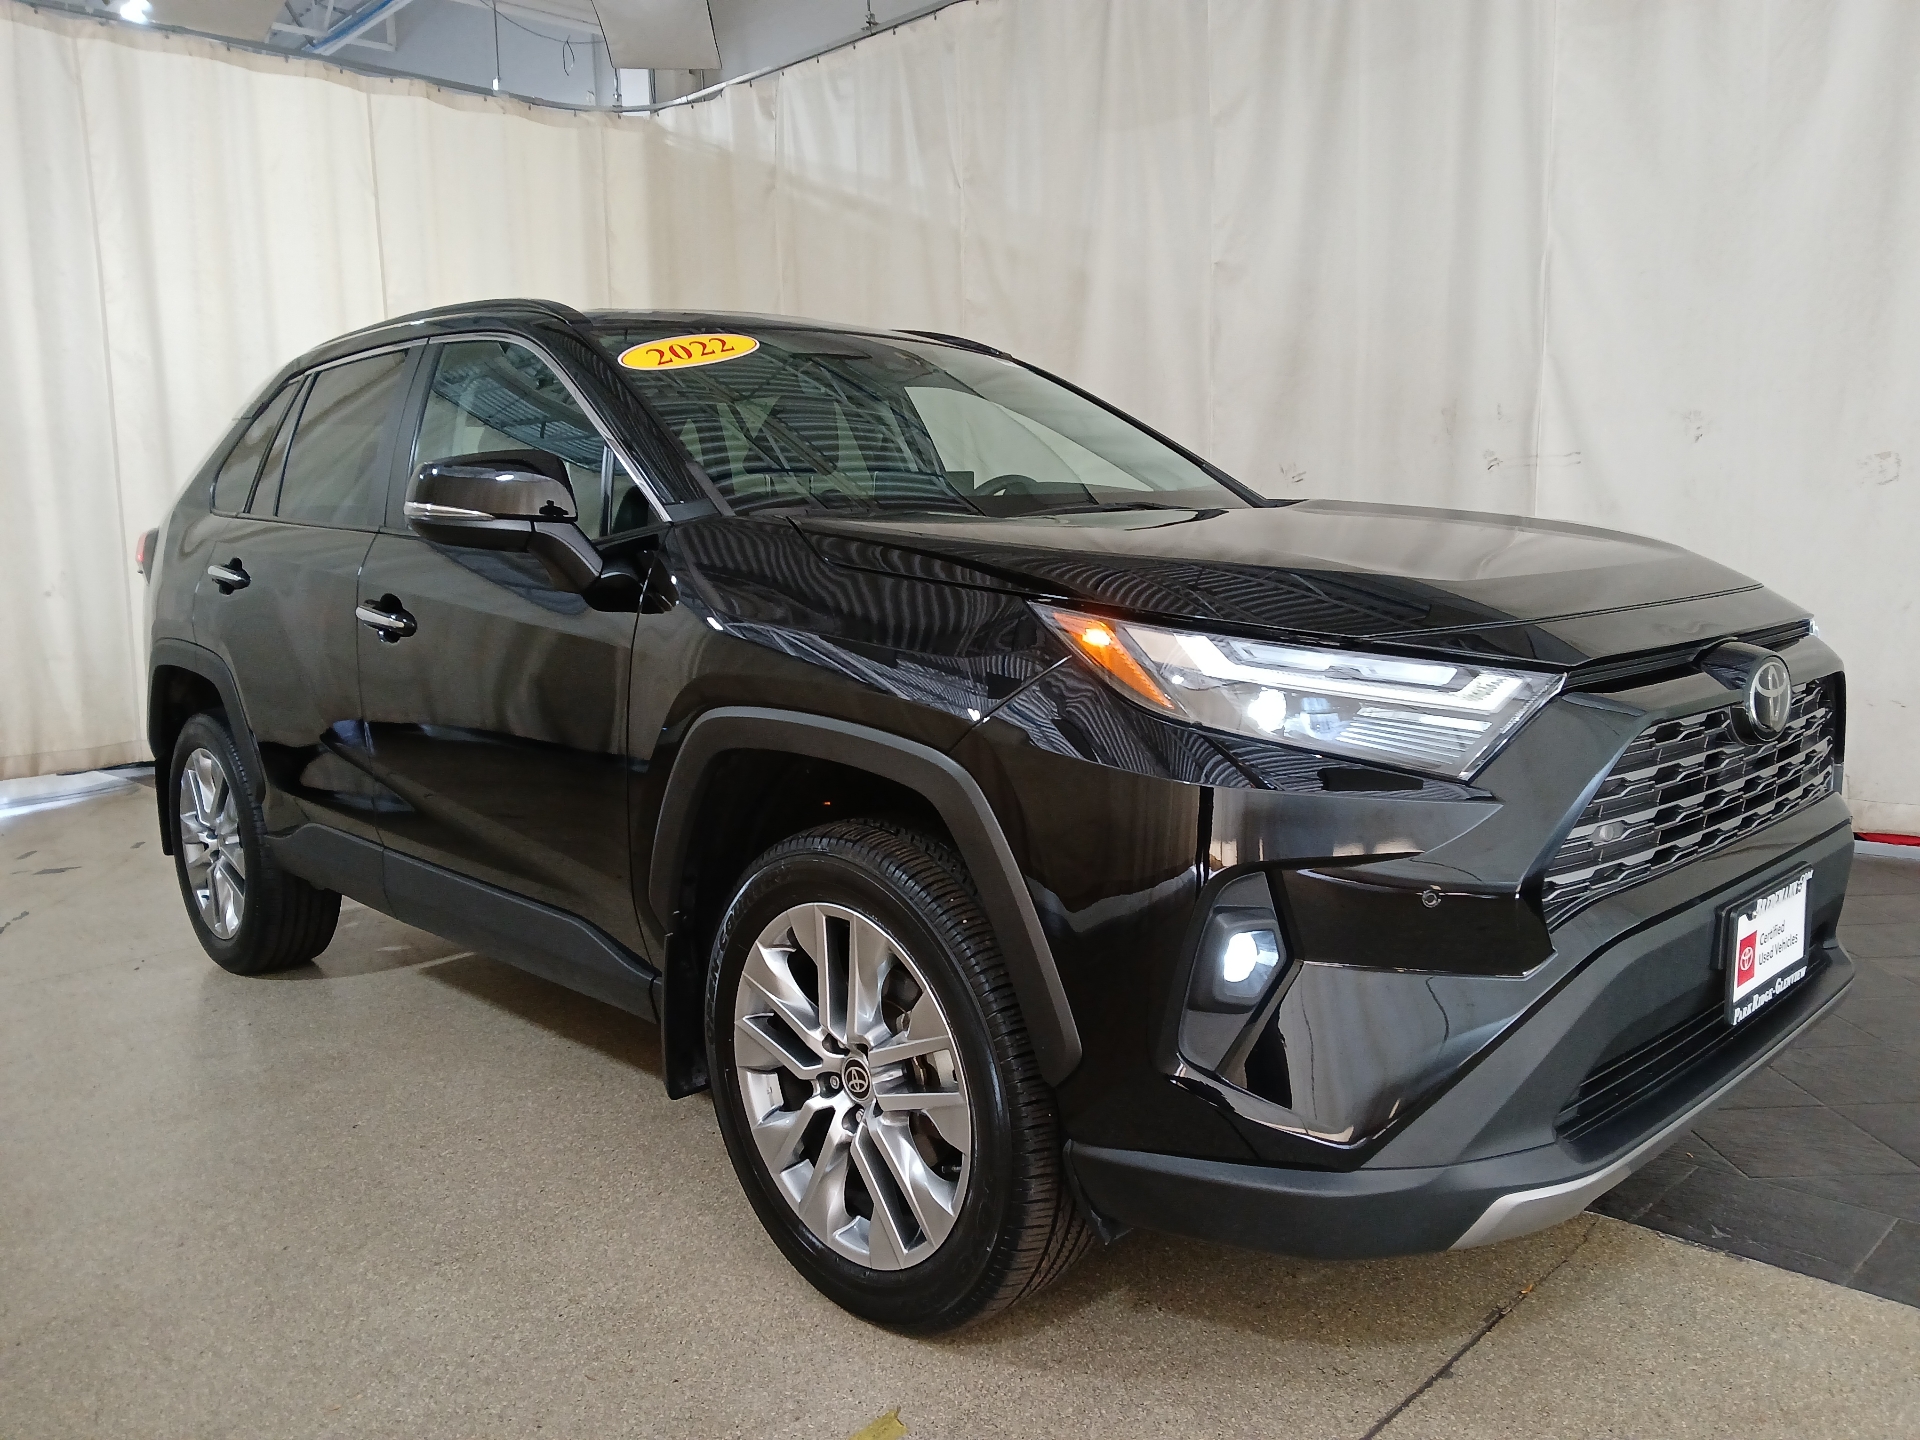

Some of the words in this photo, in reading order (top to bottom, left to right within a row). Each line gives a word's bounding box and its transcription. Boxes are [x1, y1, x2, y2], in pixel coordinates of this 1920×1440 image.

[646, 338, 735, 366] 2022
[1760, 920, 1786, 945] Certified
[1758, 946, 1775, 966] Used
[1773, 933, 1799, 956] Vehicles
[1733, 1002, 1752, 1025] PARK
